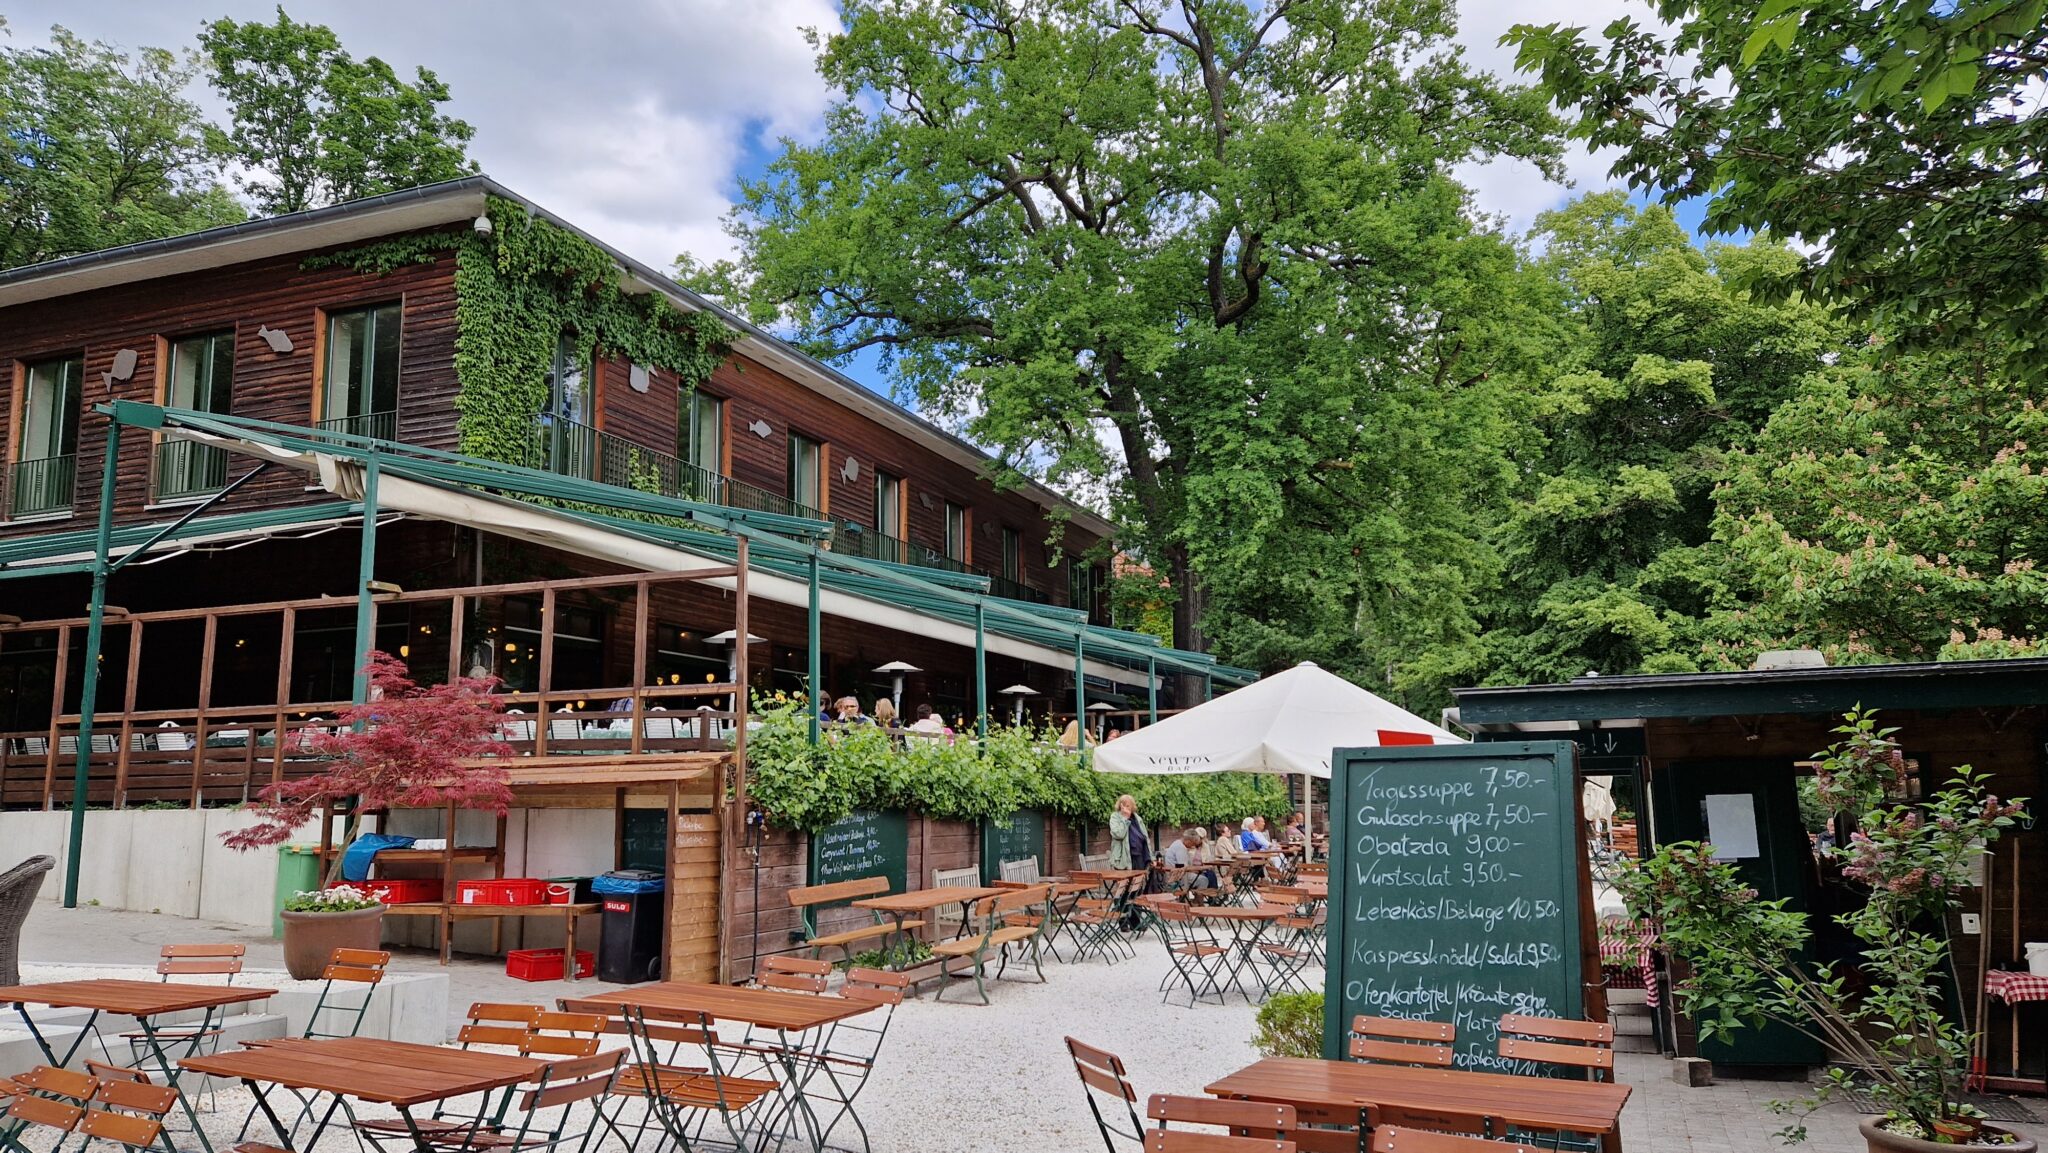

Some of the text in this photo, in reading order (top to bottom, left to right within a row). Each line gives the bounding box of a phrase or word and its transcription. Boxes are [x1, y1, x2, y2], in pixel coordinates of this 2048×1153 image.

[1358, 766, 1474, 811] Tagessuppe
[1357, 806, 1482, 836] Gulaschsuppe
[1357, 833, 1452, 857] Obatzda
[1356, 858, 1454, 887] Wurstsalat
[607, 902, 626, 911] SULO
